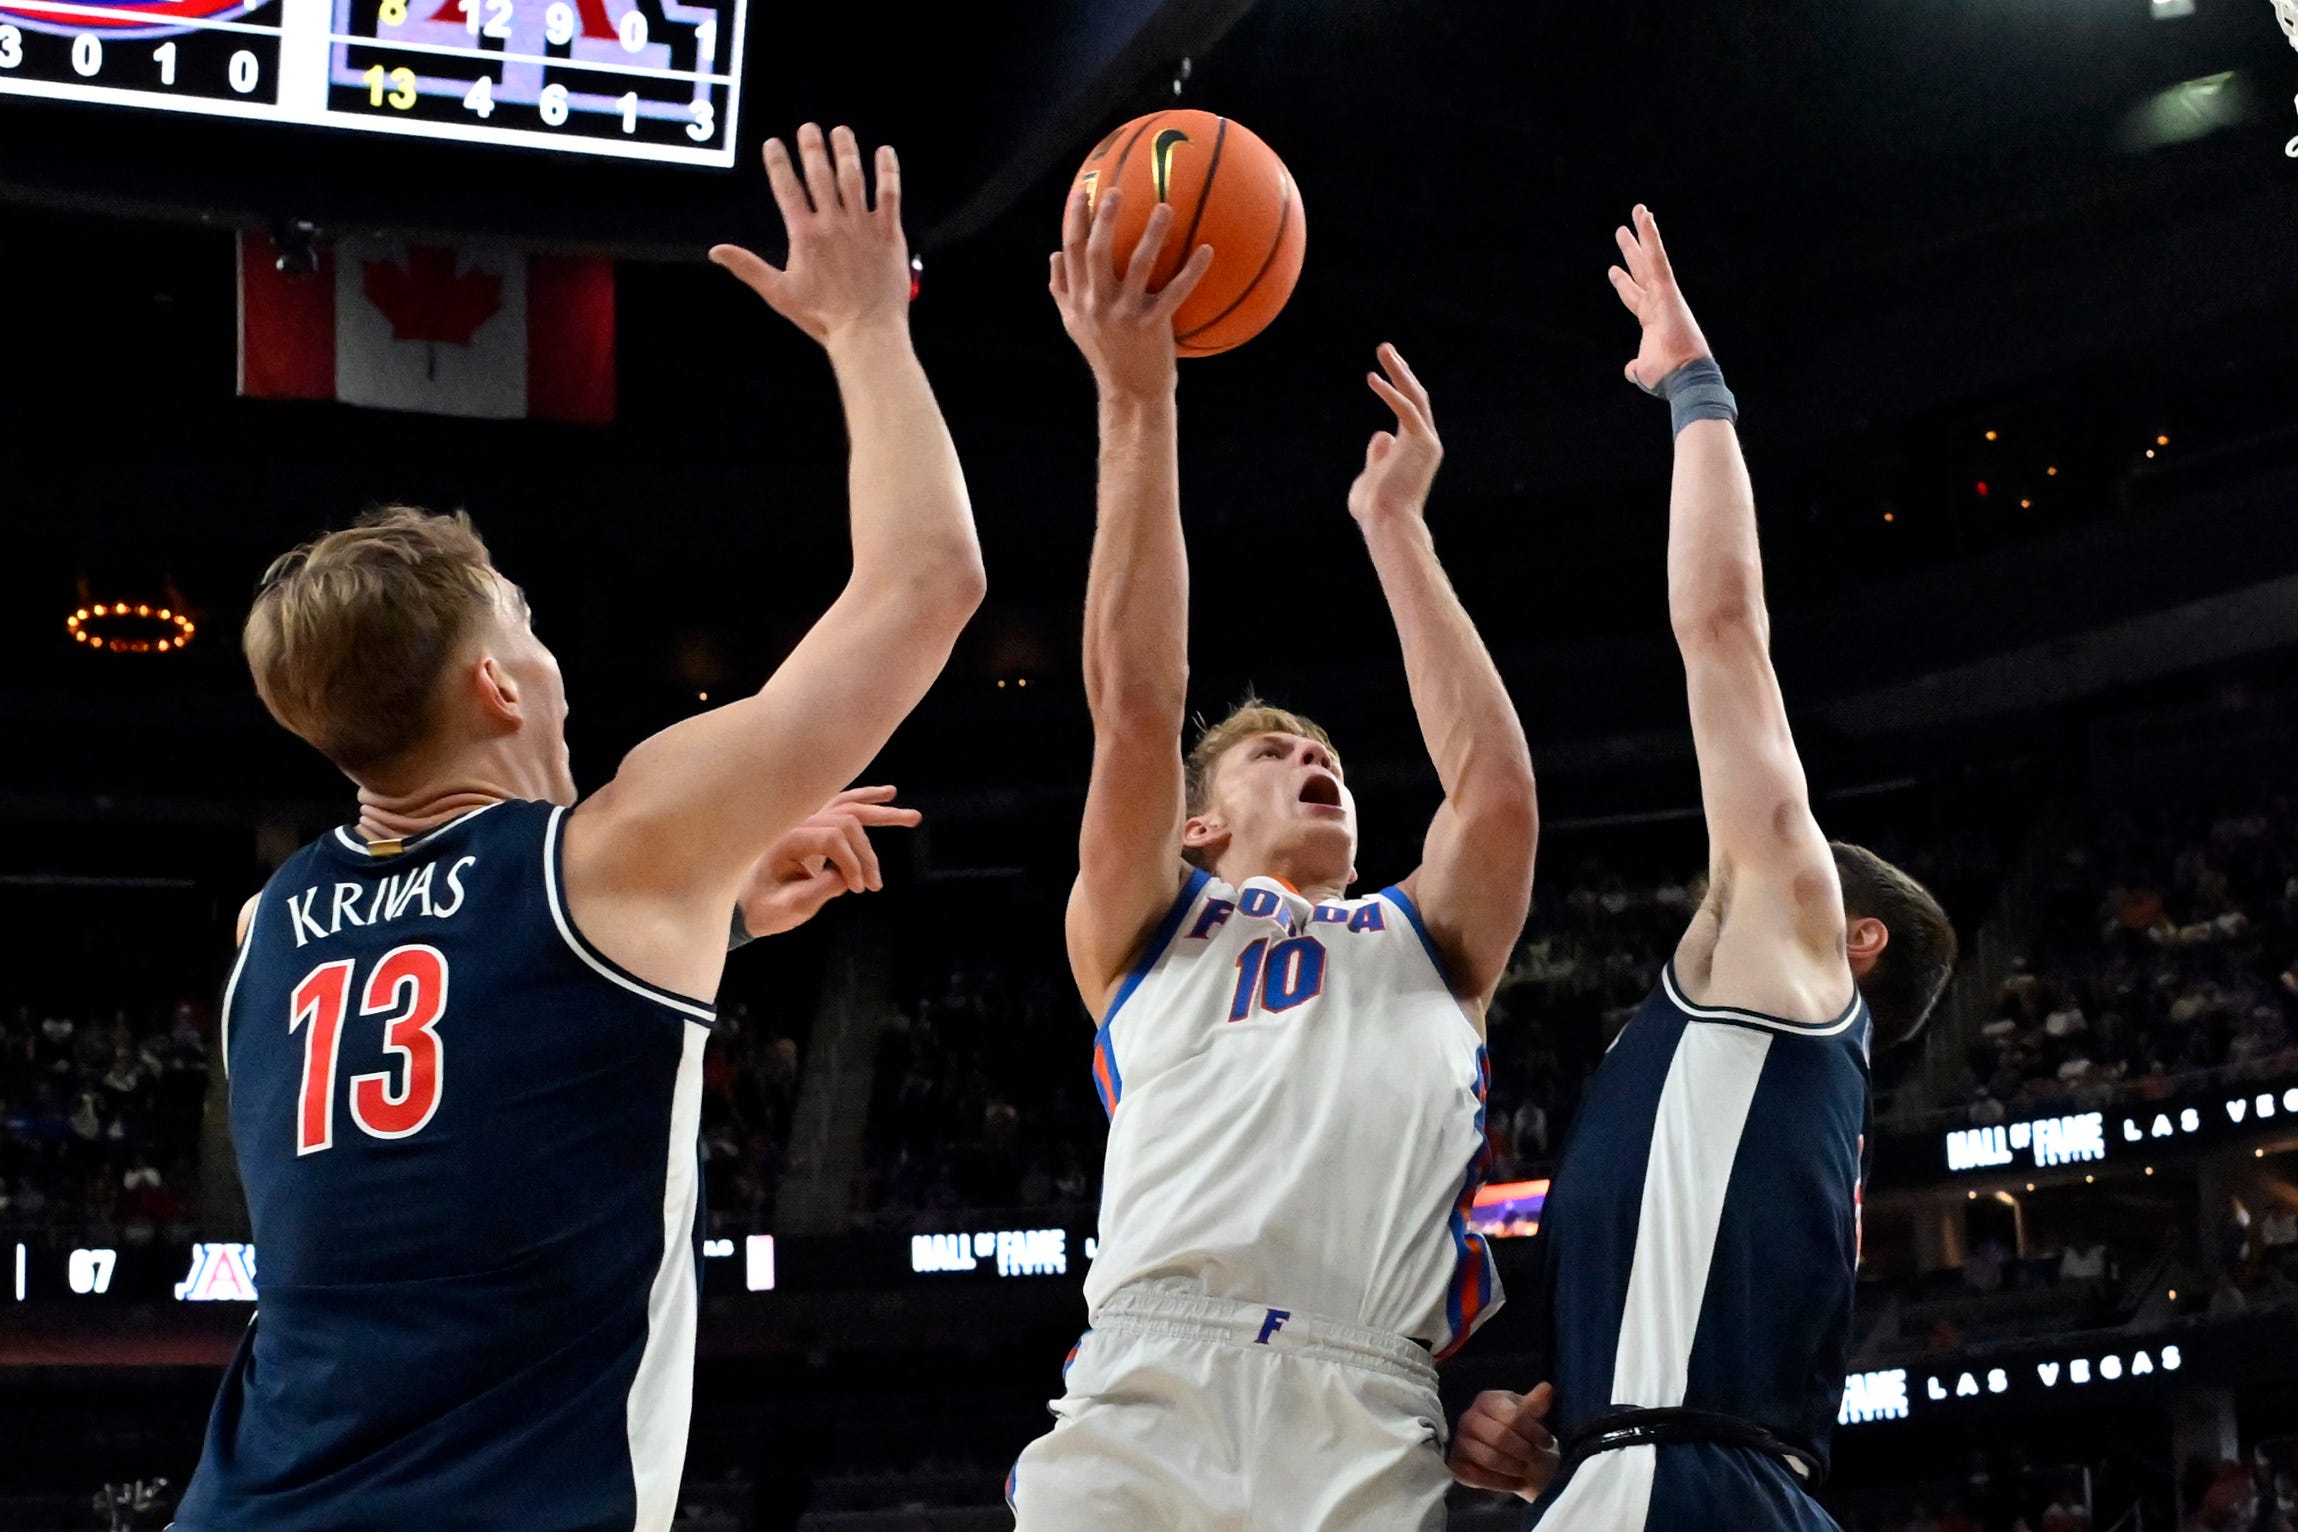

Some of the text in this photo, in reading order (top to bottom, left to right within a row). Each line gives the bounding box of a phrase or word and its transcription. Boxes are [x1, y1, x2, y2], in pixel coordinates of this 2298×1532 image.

[458, 0, 513, 38] 12
[545, 3, 574, 45] 9
[619, 10, 648, 53] 0
[694, 19, 717, 61] 1
[71, 33, 102, 77] 0
[153, 42, 176, 85] 1
[229, 50, 259, 93] 0
[362, 65, 715, 141] 13 4 6 1 3
[286, 855, 476, 948] KRIVAS
[1184, 887, 1385, 939] FODA
[1228, 936, 1326, 1022] 10
[288, 943, 449, 1156] 13
[2124, 1108, 2199, 1141] LAS
[1253, 1308, 1291, 1345] F
[1928, 1368, 2007, 1399] LAS
[2038, 1345, 2180, 1386] VEGAS
